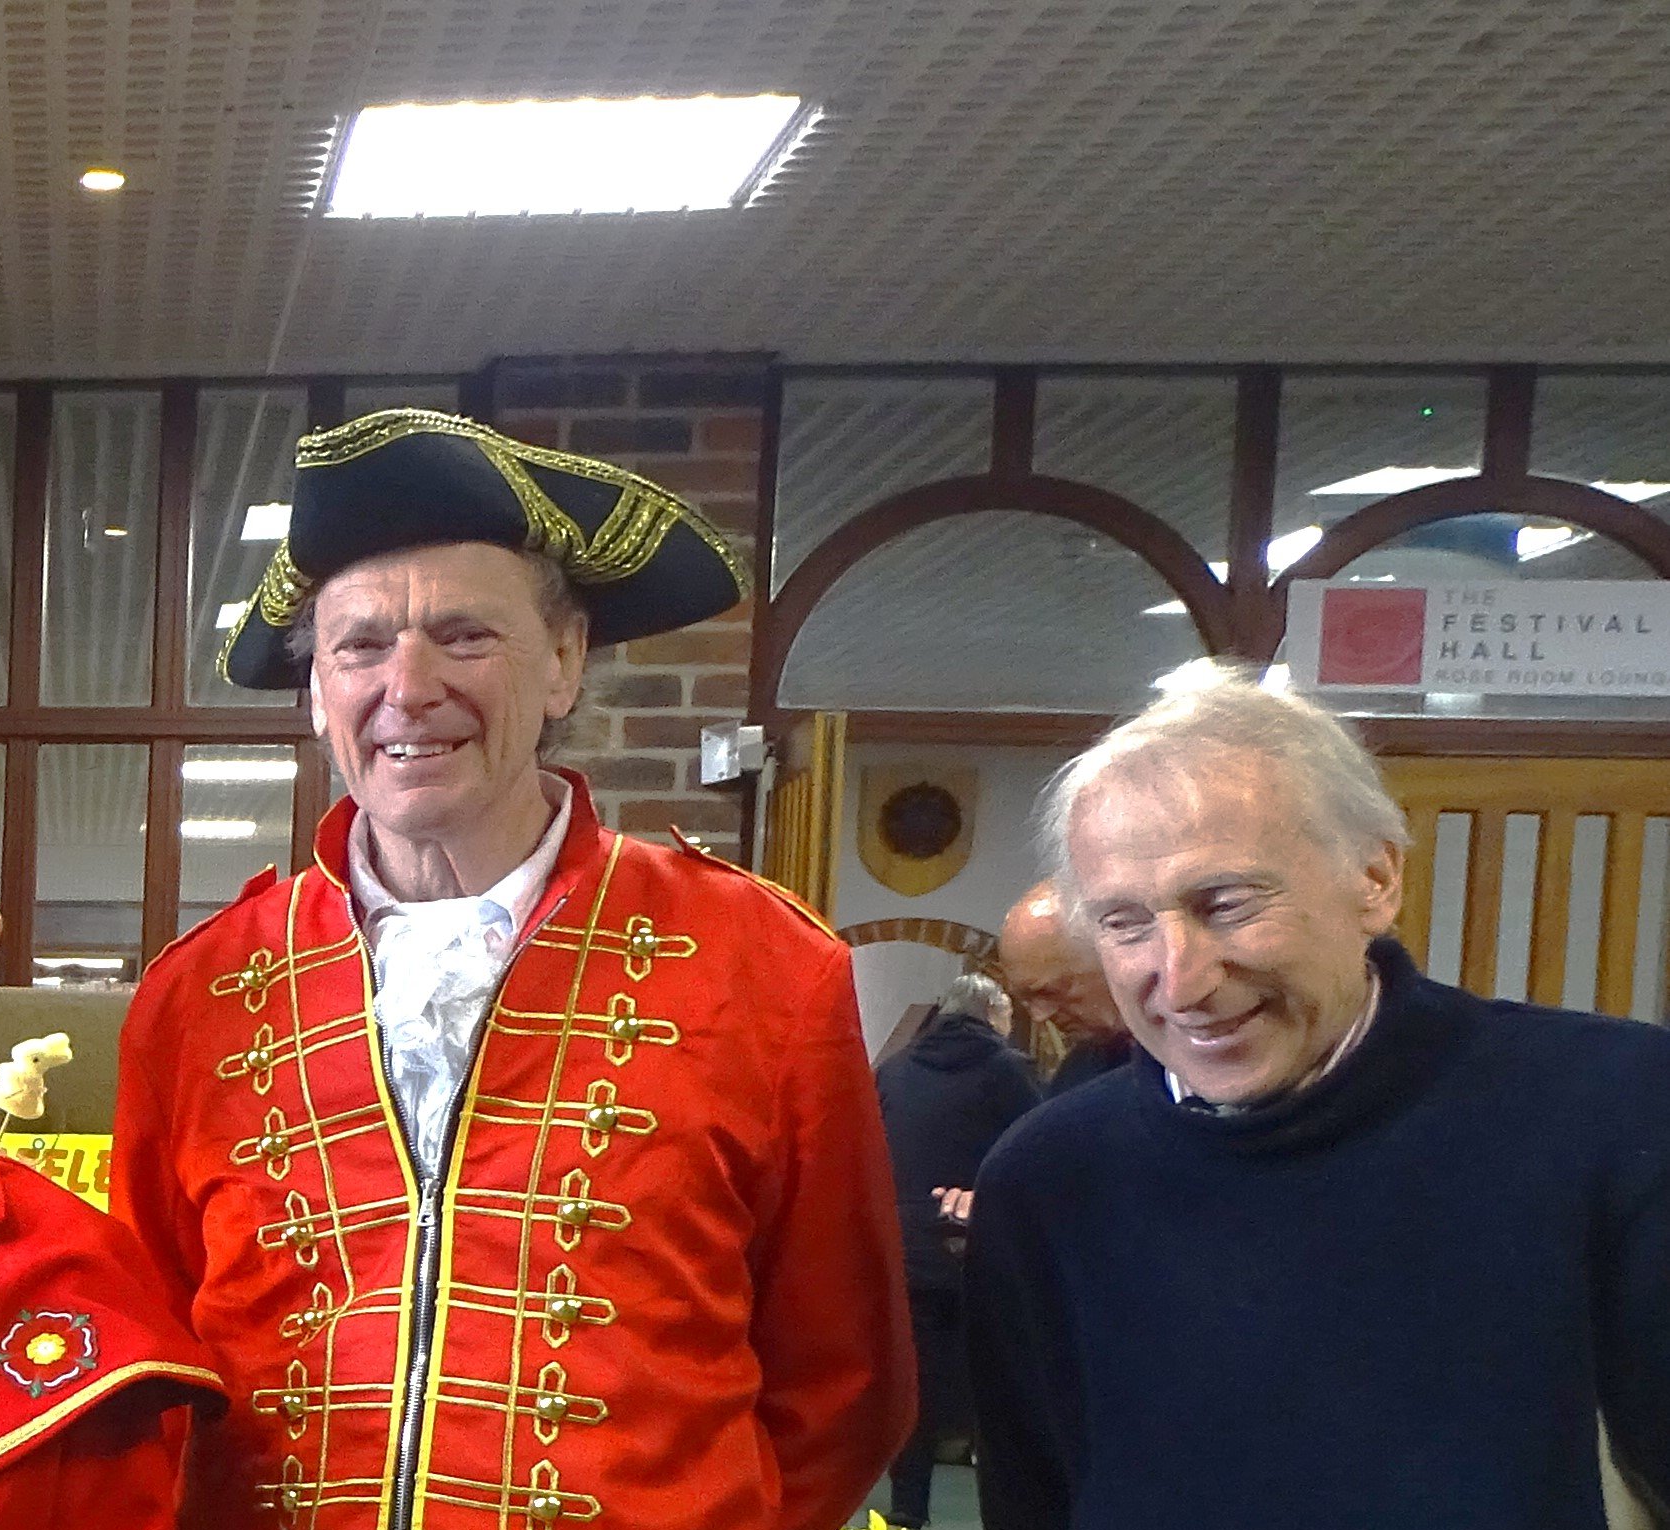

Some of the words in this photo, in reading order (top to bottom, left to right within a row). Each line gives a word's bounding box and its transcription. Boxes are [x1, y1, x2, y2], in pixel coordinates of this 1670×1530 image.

[1444, 589, 1496, 605] THE
[1441, 613, 1652, 633] FESTIVAL
[1438, 641, 1545, 662] HALL
